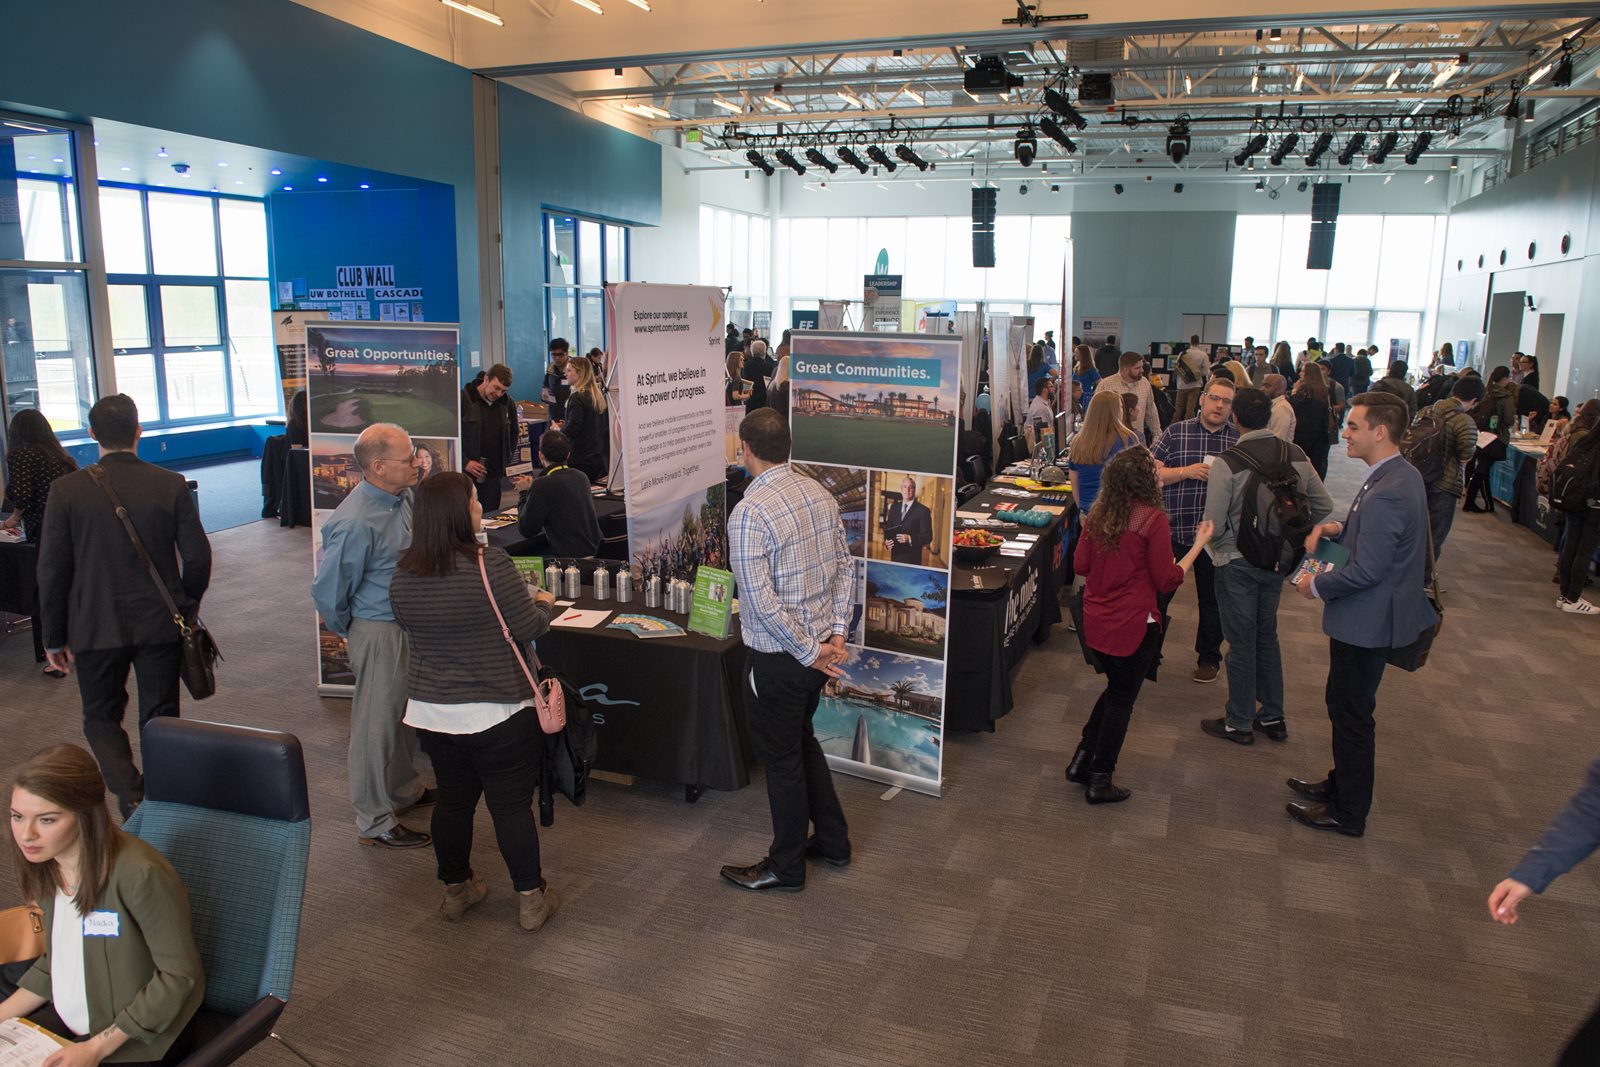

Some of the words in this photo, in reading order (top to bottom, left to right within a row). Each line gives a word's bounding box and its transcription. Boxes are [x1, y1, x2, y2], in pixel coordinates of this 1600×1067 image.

[338, 267, 362, 286] CLUB
[366, 266, 394, 286] WALL
[310, 290, 324, 298] UW
[327, 290, 366, 298] BOTHELL
[634, 310, 652, 320] Explore
[662, 311, 683, 320] openings
[634, 323, 690, 334] www.sprint.com/careers
[708, 336, 720, 346] Sprint
[325, 348, 360, 359] Great
[362, 348, 454, 361] Opportunities.
[796, 360, 832, 374] Great
[836, 362, 930, 379] Communities.
[636, 374, 644, 387] At
[646, 371, 667, 387] Sprint,
[668, 372, 677, 382] we
[678, 368, 699, 381] believe
[700, 366, 706, 378] in
[637, 393, 648, 406] the
[650, 390, 670, 406] power
[671, 387, 678, 400] of
[678, 385, 706, 400] progress.
[641, 479, 651, 490] Let's
[652, 476, 664, 488] Move
